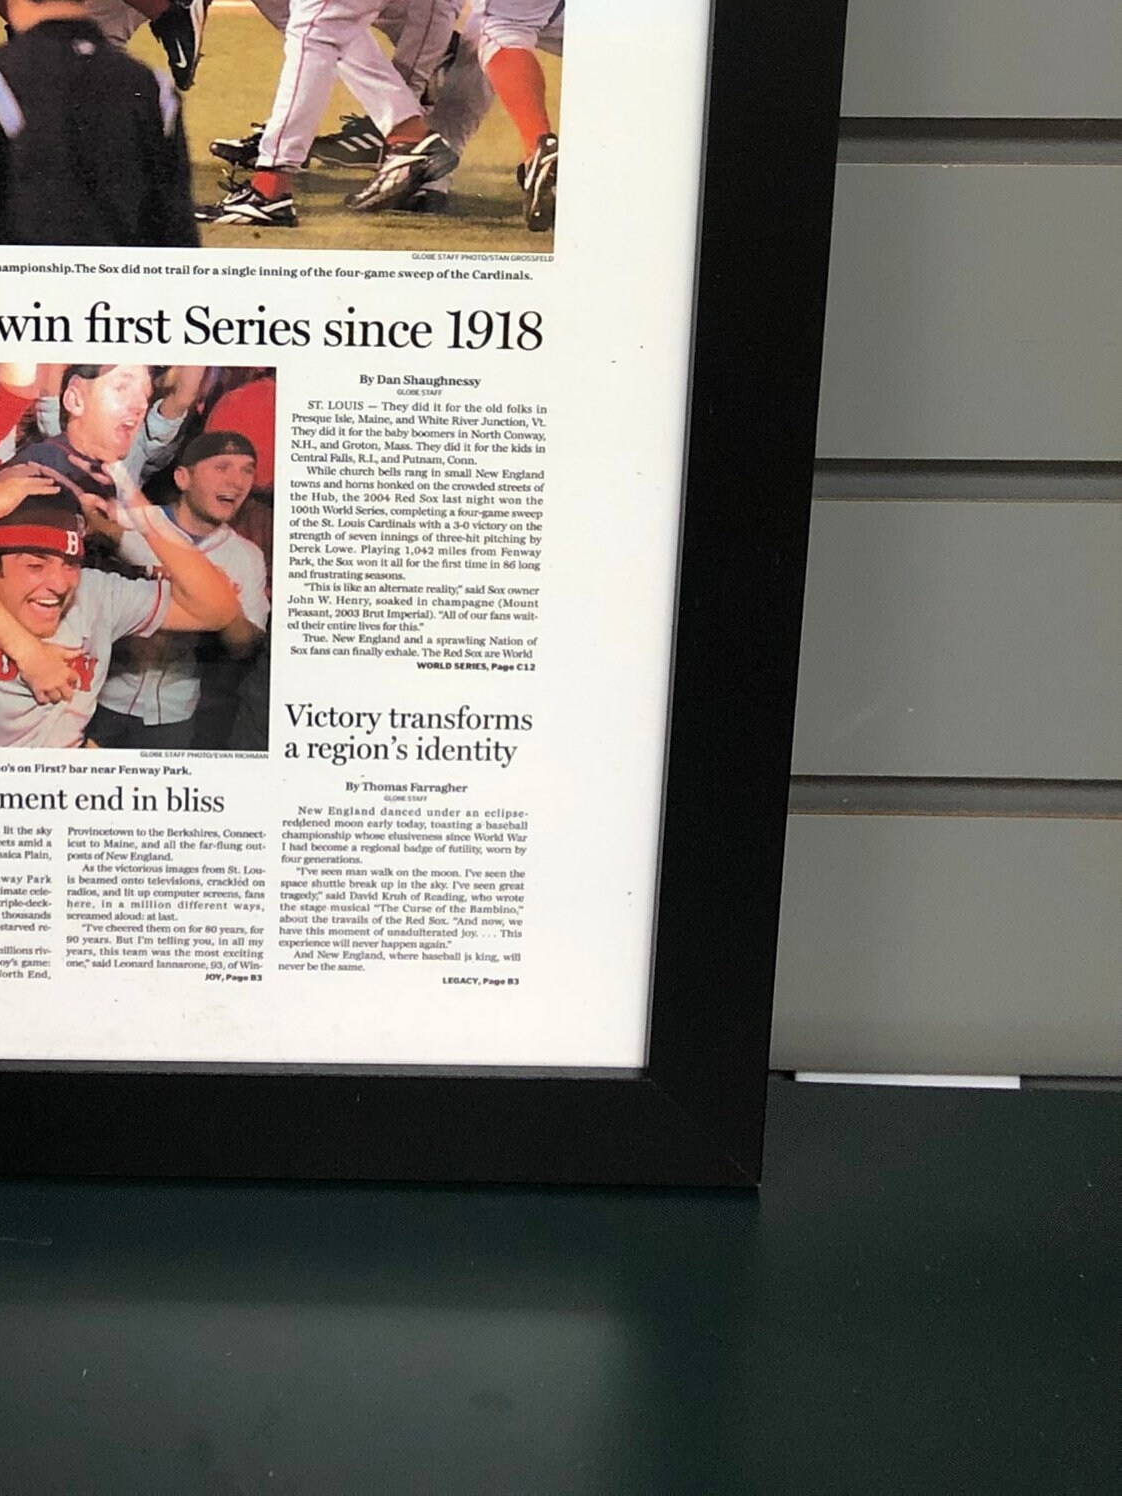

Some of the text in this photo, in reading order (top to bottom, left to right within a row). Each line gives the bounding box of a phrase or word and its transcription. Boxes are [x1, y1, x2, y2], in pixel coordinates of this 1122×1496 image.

[511, 254, 553, 262] GROSSFELD
[98, 264, 118, 273] Sox
[121, 265, 139, 273] did
[143, 266, 162, 274] not
[165, 265, 189, 274] trail
[193, 265, 209, 274] for
[221, 266, 256, 277] single
[259, 266, 297, 278] inning
[300, 267, 312, 276] of
[314, 267, 332, 276] the
[335, 267, 395, 279] four-game
[398, 271, 433, 280] sweep
[436, 269, 449, 278] of
[451, 269, 469, 278] the
[472, 270, 532, 279] Cardinals.
[85, 301, 170, 343] first
[184, 305, 309, 346] Series
[324, 306, 431, 348] since
[446, 310, 542, 350] 1918
[360, 374, 480, 388] By Dan Shaughnessy
[307, 400, 546, 413] ST. LOUIS They did it for the old folks in
[454, 662, 488, 670] SERIES,
[491, 663, 513, 671] Page
[285, 703, 532, 734] Victory transforms
[285, 735, 517, 767] a region's identity
[35, 764, 66, 772] First?
[69, 764, 87, 773] bar
[119, 765, 160, 776] Fenway
[163, 766, 191, 774] Park.
[346, 781, 467, 794] By Thomas Farragher
[75, 786, 123, 810] end
[133, 787, 157, 810] in
[166, 787, 223, 812] bliss
[298, 806, 322, 814] New
[328, 806, 374, 816] England
[380, 807, 420, 816] danced
[427, 808, 460, 816] under
[484, 808, 527, 819] eclipse-
[205, 973, 223, 982] JOY,
[226, 974, 248, 982] Page
[443, 977, 480, 985] LEGACY,
